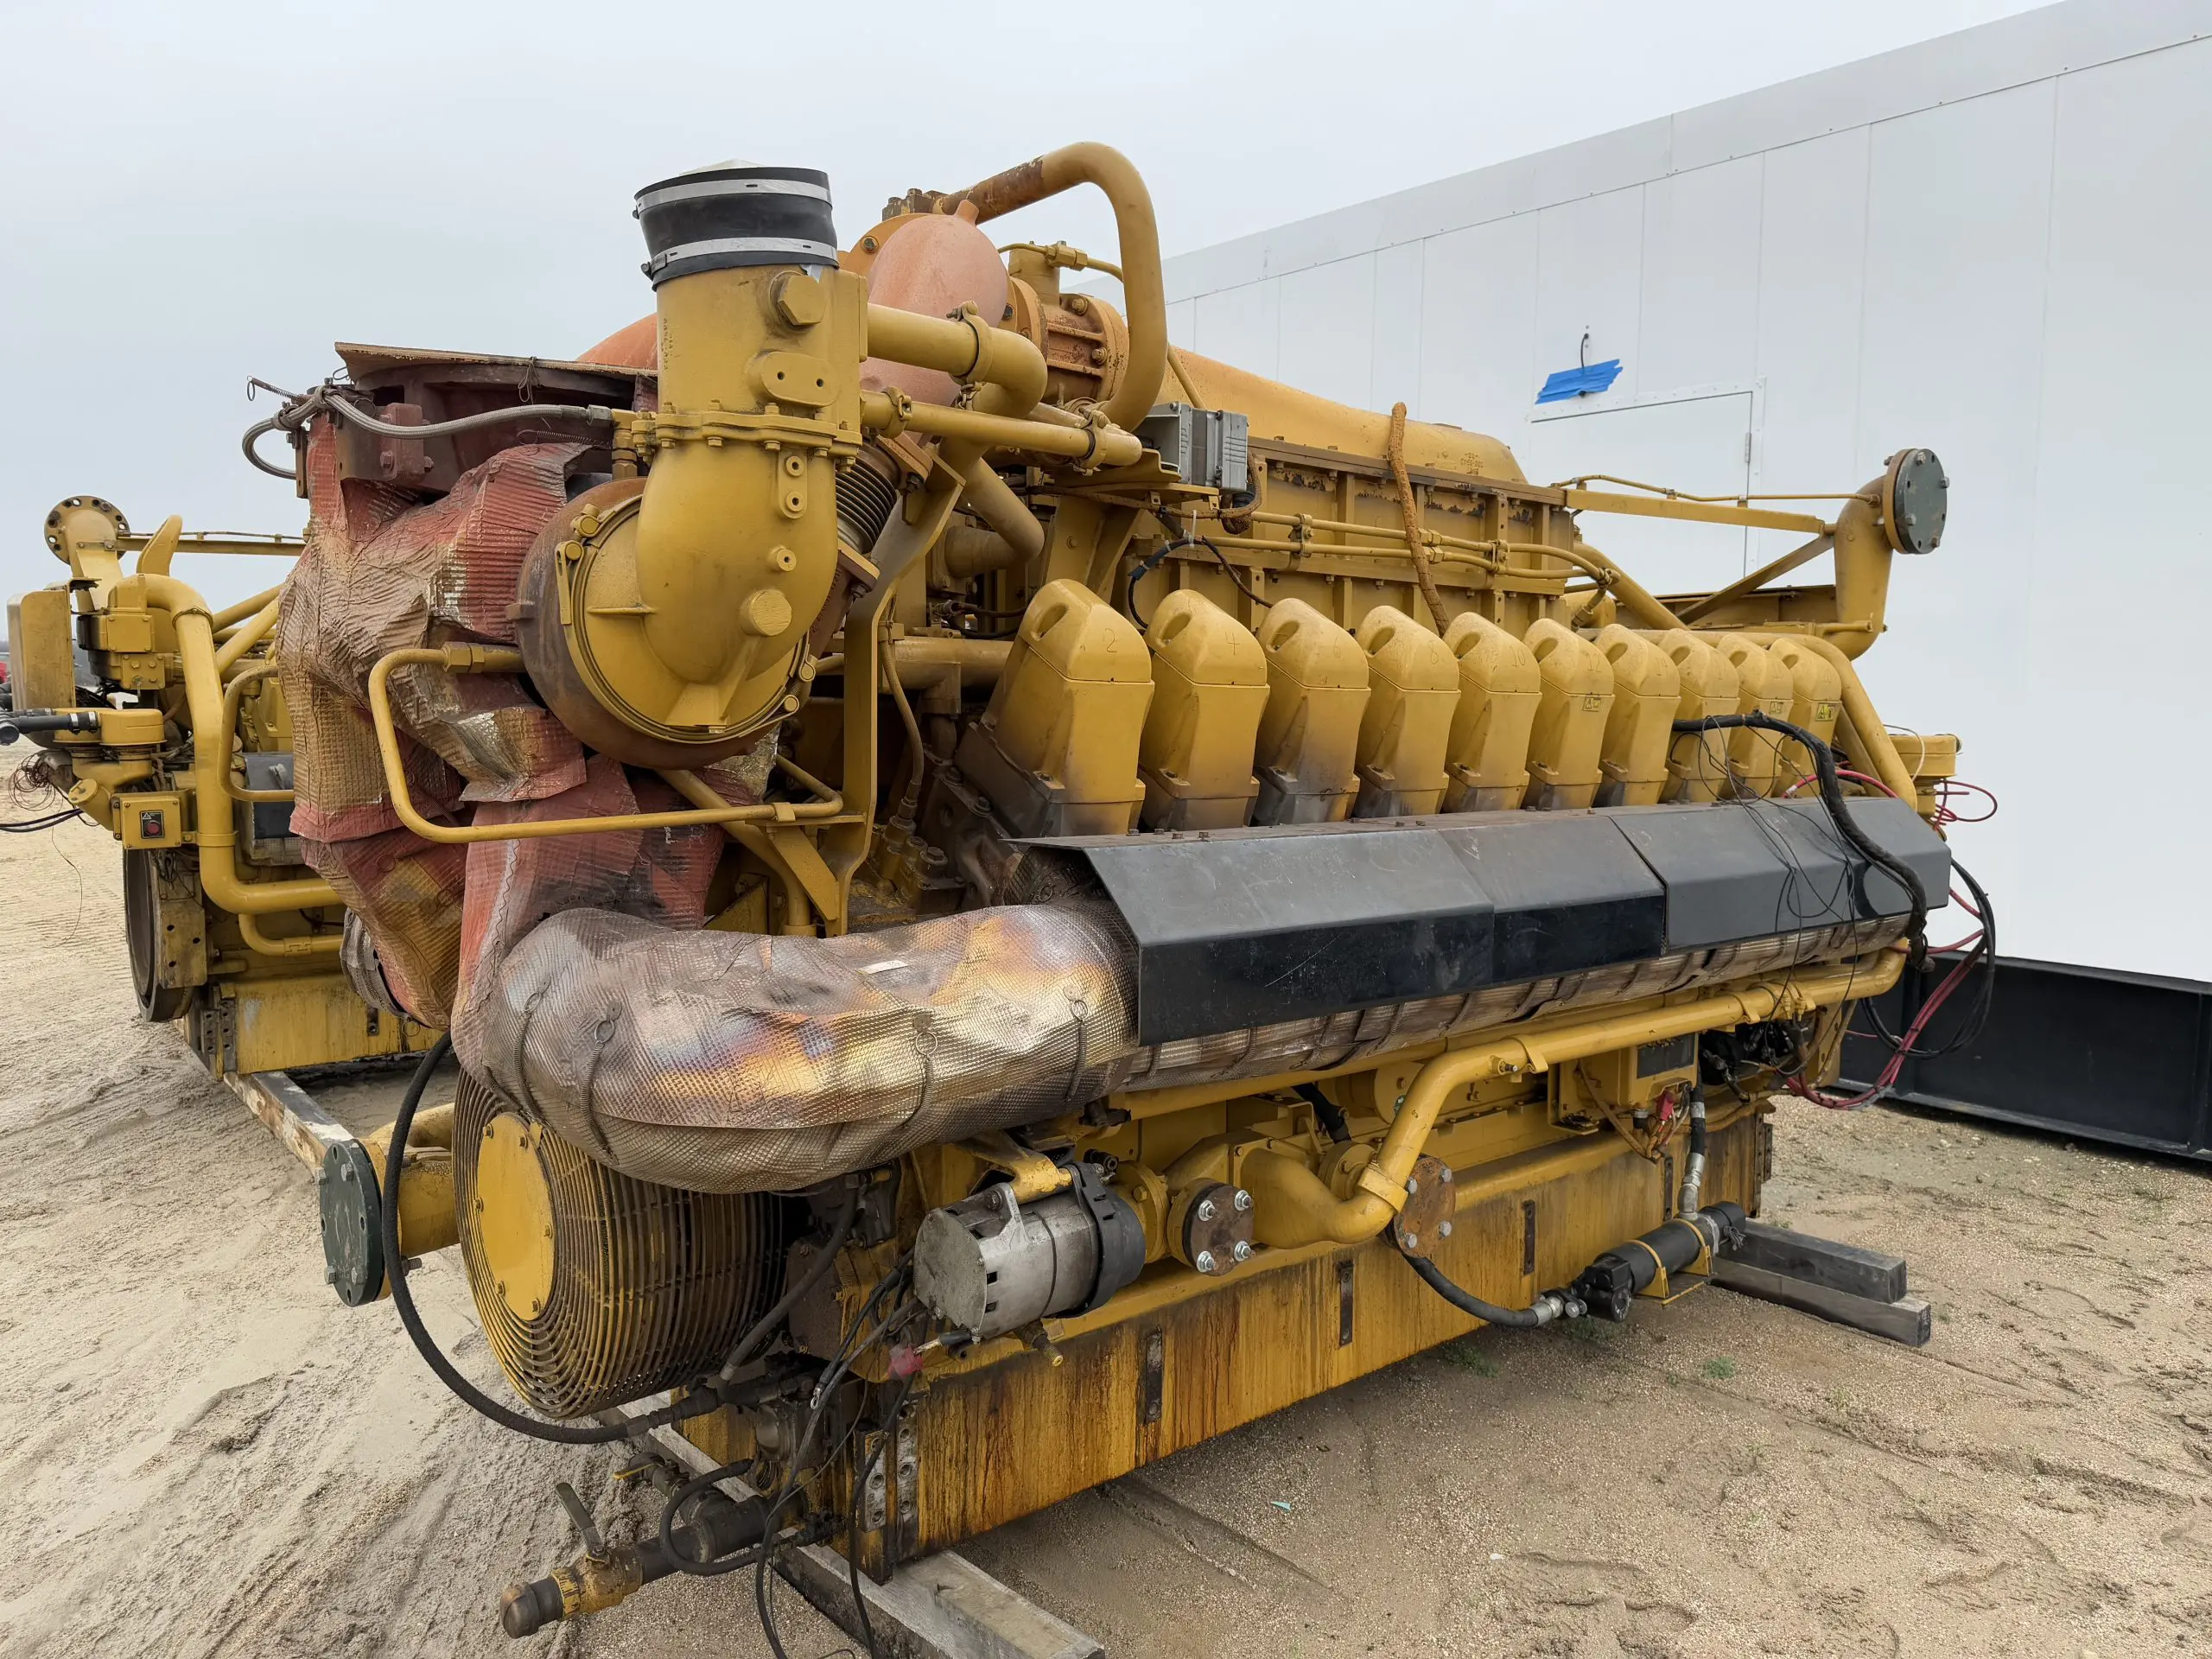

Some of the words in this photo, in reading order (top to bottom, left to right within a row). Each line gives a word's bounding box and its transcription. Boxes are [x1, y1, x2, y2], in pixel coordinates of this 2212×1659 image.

[1104, 627, 1118, 653] 2
[1224, 630, 1240, 656] 4
[1508, 642, 1526, 668] 10
